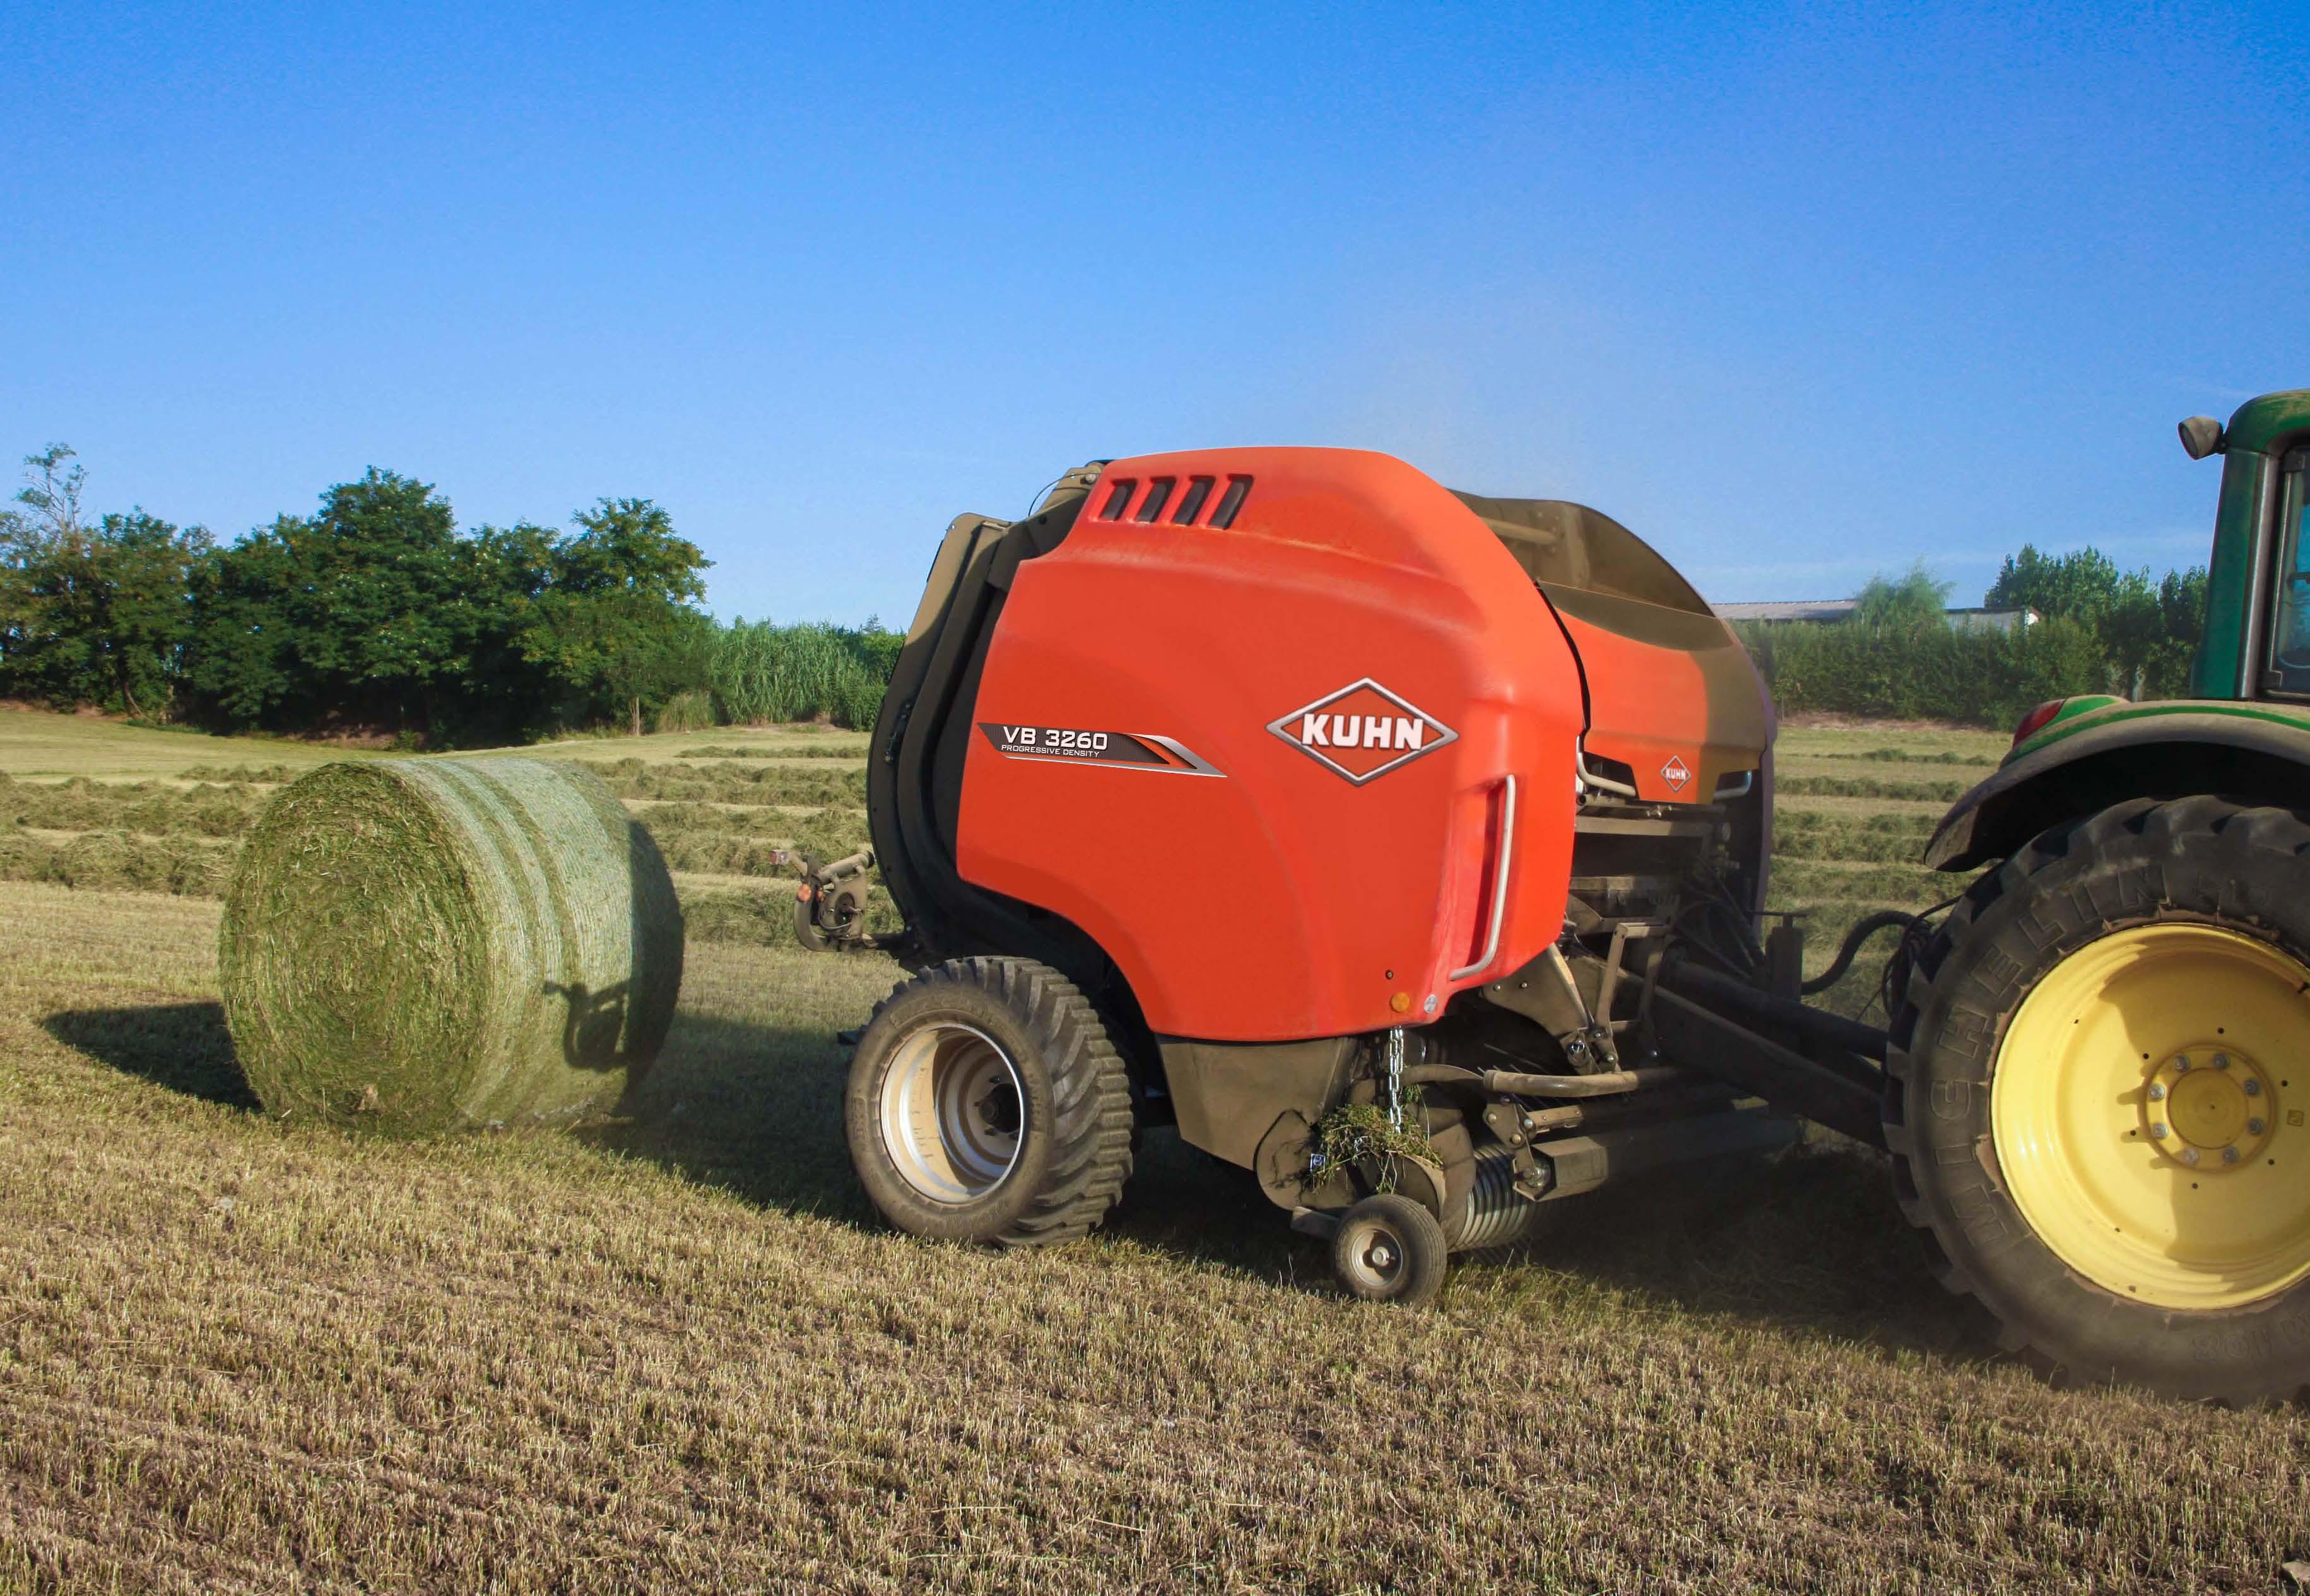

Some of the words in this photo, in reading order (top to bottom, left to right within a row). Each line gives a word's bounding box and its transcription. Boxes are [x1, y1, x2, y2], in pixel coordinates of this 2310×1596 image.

[1003, 726, 1036, 744] VB
[1045, 729, 1107, 750] 3260
[1302, 713, 1423, 750] KUHN
[1001, 744, 1061, 754] PROGRESSIVE
[1063, 749, 1100, 757] DENSITY
[1666, 767, 1686, 780] KUHN
[1930, 864, 2169, 1249] MICHELIN
